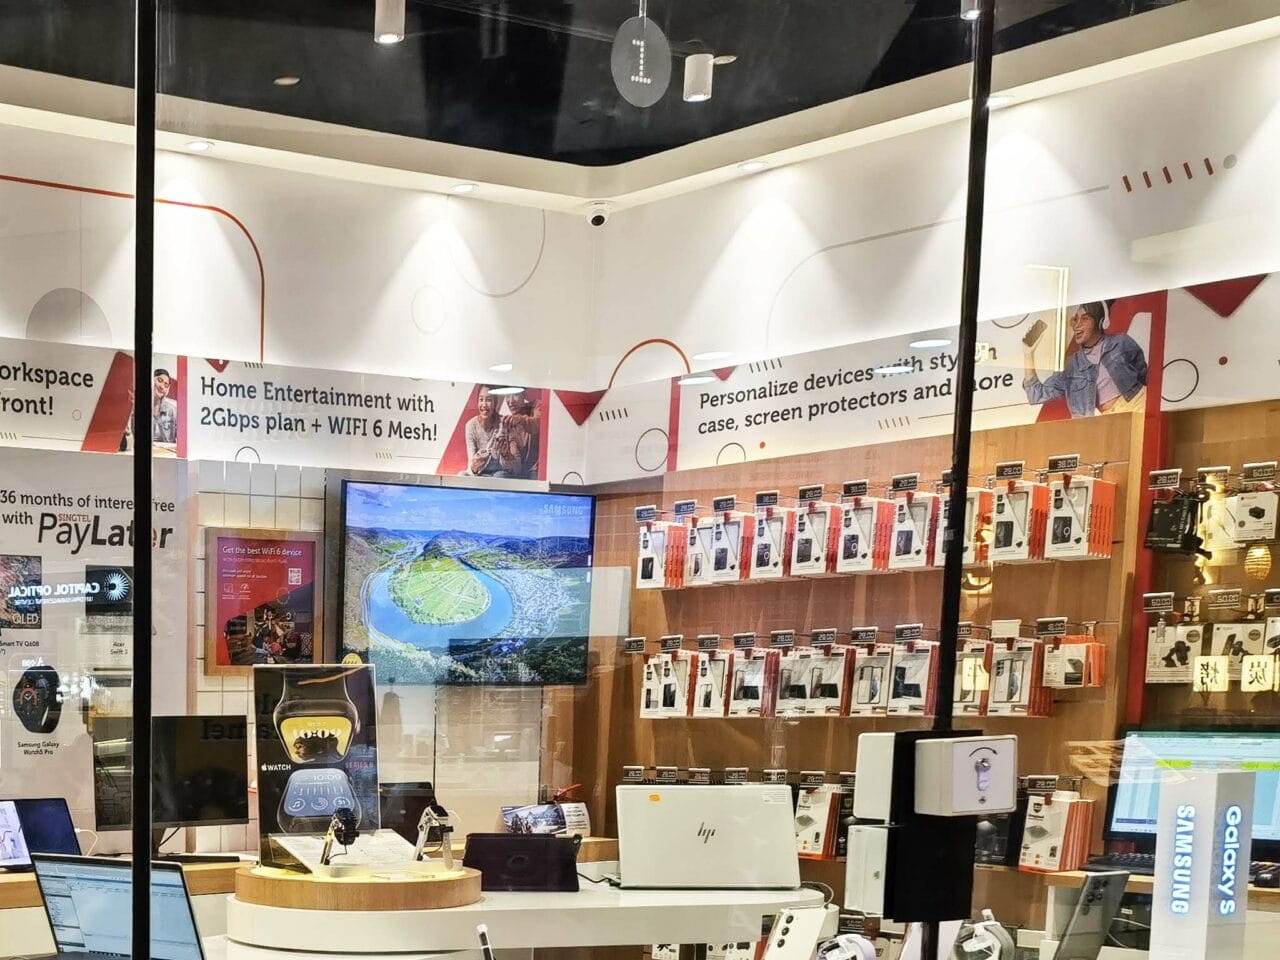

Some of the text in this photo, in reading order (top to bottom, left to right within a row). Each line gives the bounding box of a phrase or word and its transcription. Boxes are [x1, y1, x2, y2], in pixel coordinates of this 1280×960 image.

[201, 376, 435, 414] Home Entertainment with
[699, 379, 799, 409] Personalize
[803, 367, 874, 392] devices
[698, 372, 1013, 435] case, screen protectors and ore
[201, 408, 438, 442] 2Gbps plan + WIFI 6 Mesh!
[0, 490, 16, 504] 36
[21, 492, 73, 507] months
[77, 494, 92, 507] of
[152, 499, 175, 512] ree
[543, 504, 584, 516] SAMSUNG
[2, 511, 33, 525] with
[58, 513, 92, 523] SINGTEL
[12, 614, 39, 625] QLED
[697, 822, 716, 843] hp
[1171, 805, 1196, 914] SAMSUNG
[1218, 805, 1242, 915] Galaxy S
